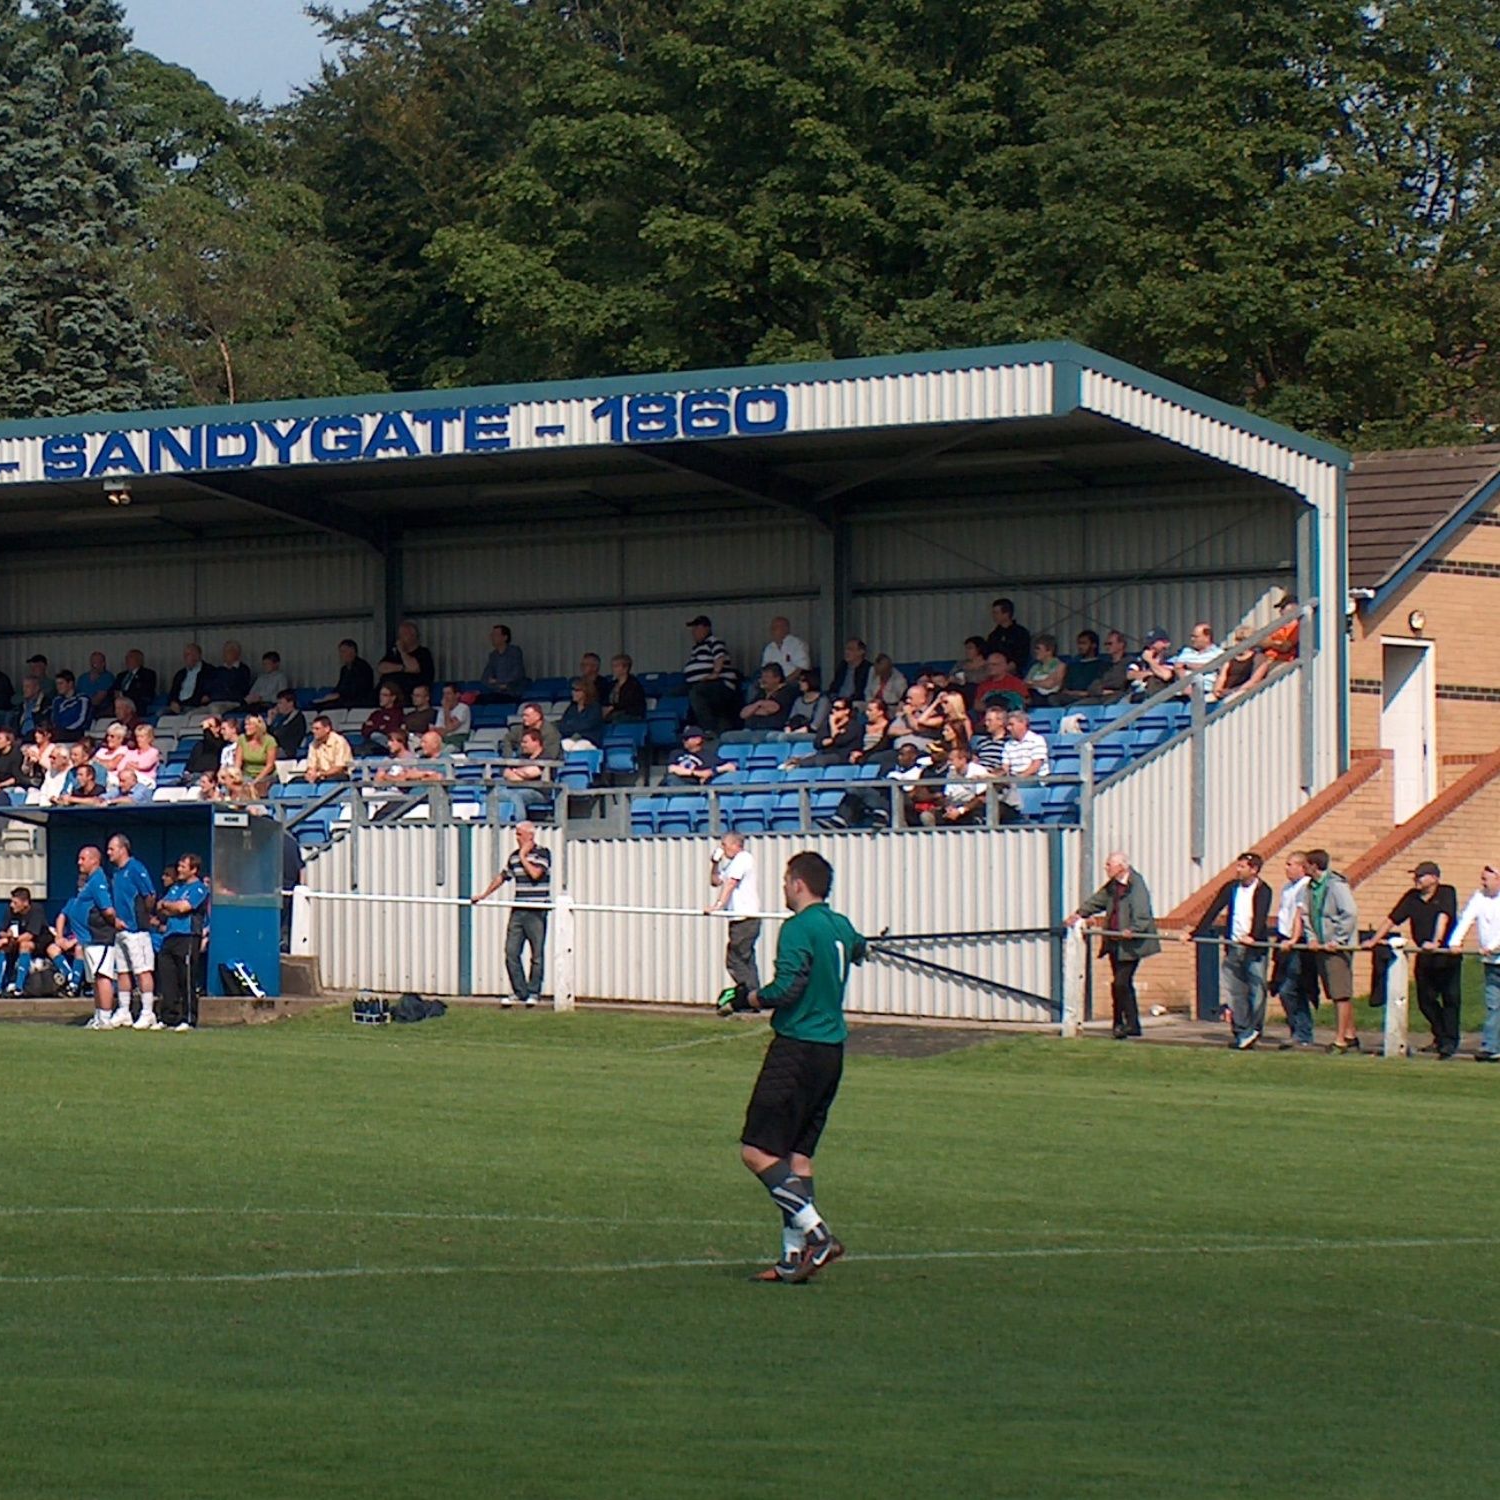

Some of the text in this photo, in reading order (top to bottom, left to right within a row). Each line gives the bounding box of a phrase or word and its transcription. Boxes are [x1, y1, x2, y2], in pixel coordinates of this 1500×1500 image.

[42, 405, 511, 480] SANDYGATE
[591, 388, 789, 443] 1860
[834, 940, 846, 983] 1
